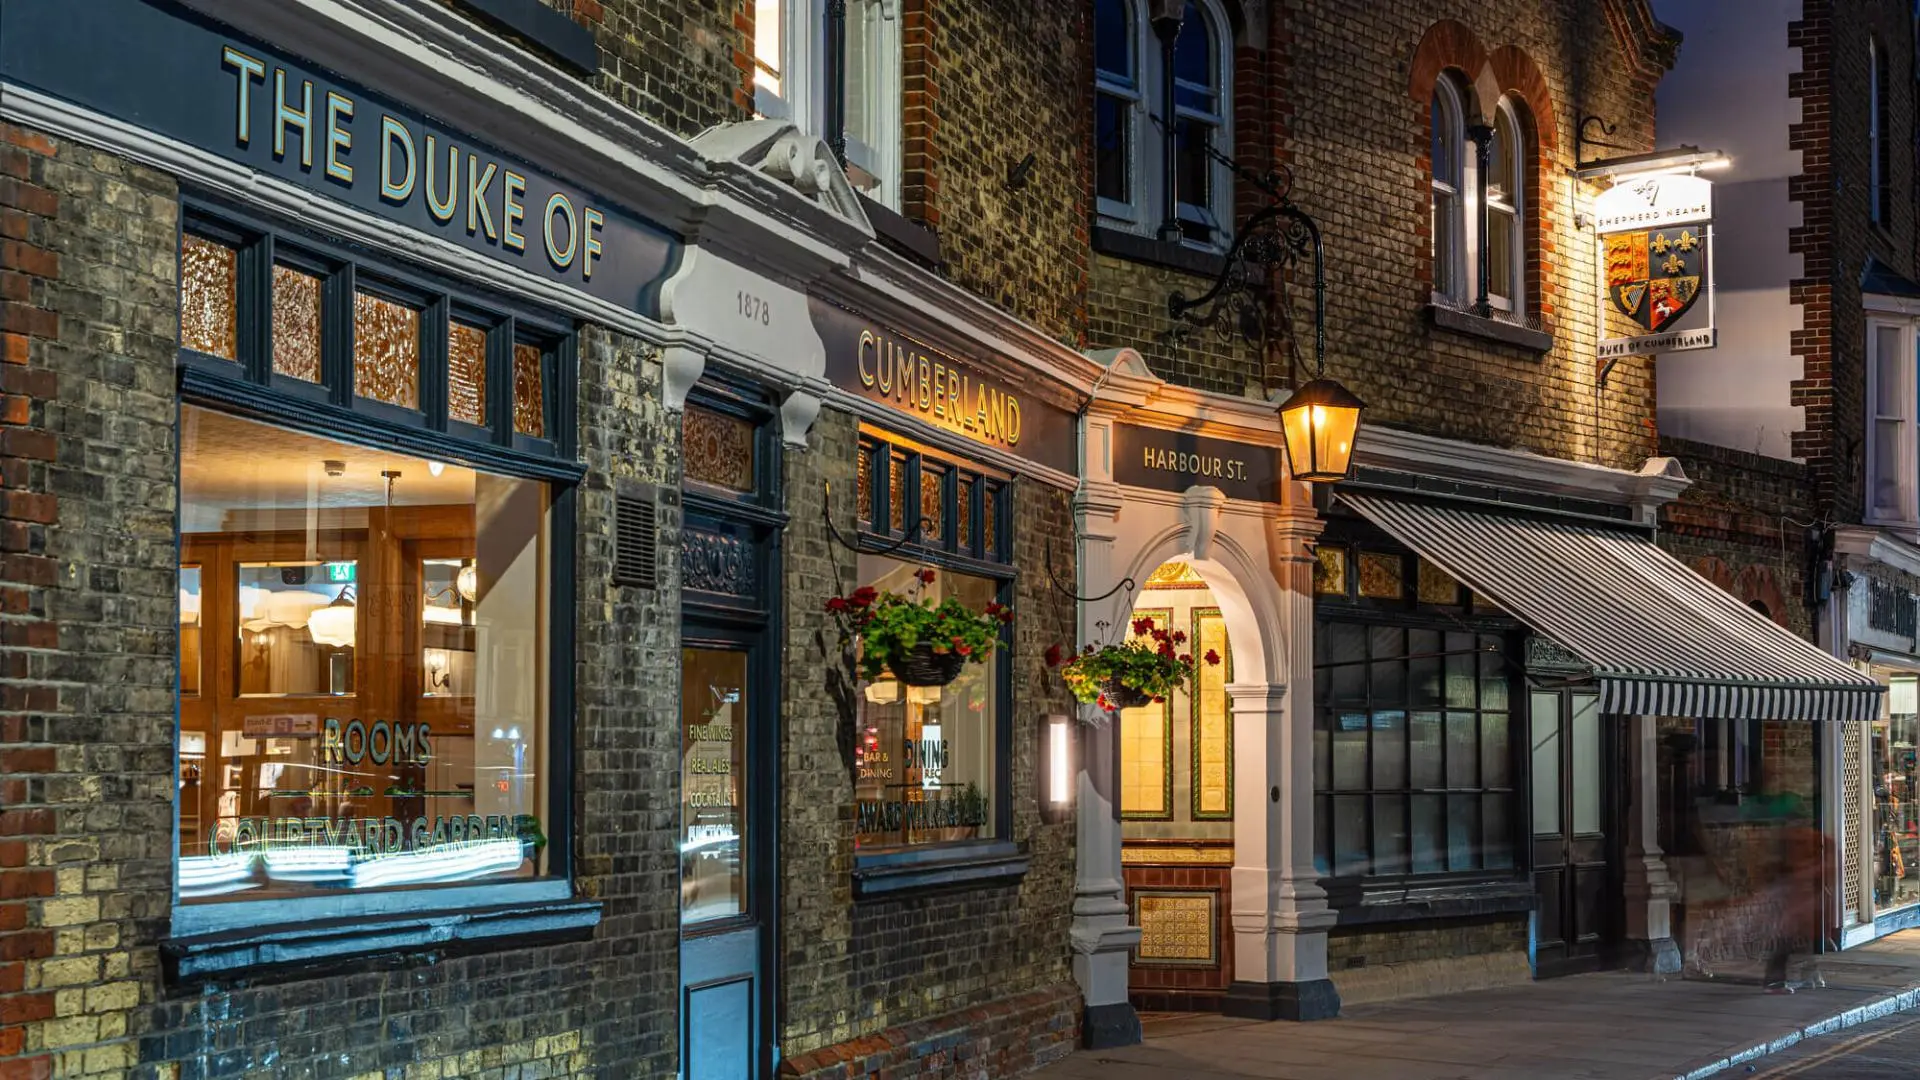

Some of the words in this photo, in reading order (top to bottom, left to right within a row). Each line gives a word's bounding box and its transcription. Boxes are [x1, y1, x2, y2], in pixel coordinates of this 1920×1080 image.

[222, 45, 355, 184] THE
[380, 113, 527, 251] DUKE
[543, 191, 605, 279] OF
[1598, 211, 1660, 227] SHEPHERD
[1666, 204, 1706, 217] NEAME
[736, 290, 770, 326] 1878
[1599, 343, 1625, 356] DUKE
[1628, 340, 1641, 352] OF
[1644, 333, 1710, 349] CUMBERLAND
[857, 329, 1022, 446] CUMBERLAND
[1144, 447, 1222, 478] HARBOUR
[1226, 459, 1248, 482] ST.
[323, 717, 433, 768] ROOMS
[689, 724, 707, 742] FINE
[707, 724, 733, 742] WINES
[690, 757, 711, 775] REAL
[712, 757, 730, 775] ALES
[863, 752, 881, 763] BAR
[882, 753, 889, 762] &
[903, 738, 949, 769] DINING
[860, 768, 893, 779] DINING
[690, 791, 732, 808] COCKTAILS
[207, 814, 404, 864] COURTYARD
[410, 814, 519, 857] GARDEN
